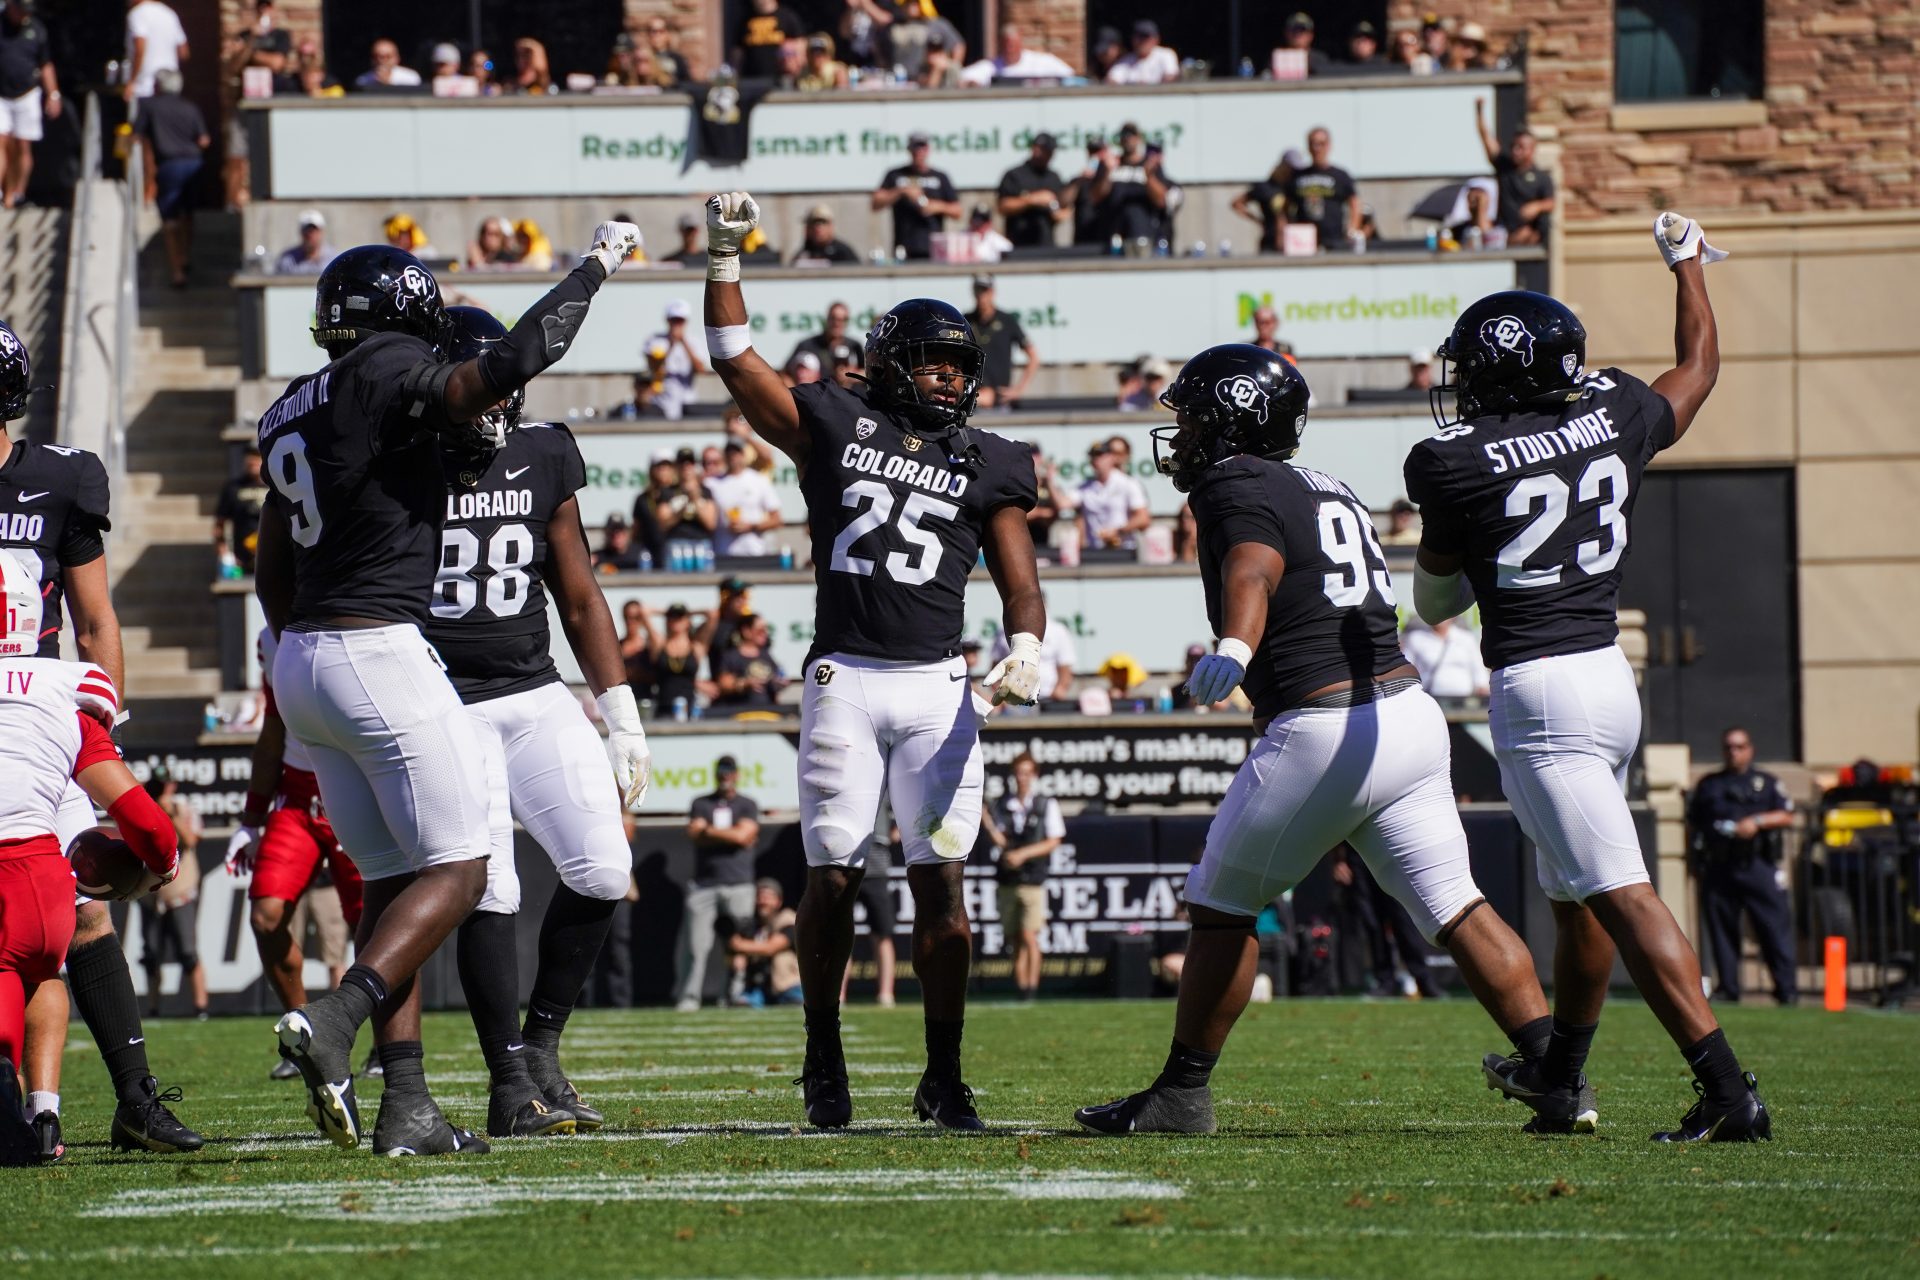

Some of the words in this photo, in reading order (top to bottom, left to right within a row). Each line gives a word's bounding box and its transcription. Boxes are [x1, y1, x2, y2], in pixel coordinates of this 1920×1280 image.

[756, 133, 847, 154] smart
[860, 126, 998, 154] finncial
[330, 304, 341, 323] 9
[1285, 293, 1458, 321] nerdwallet
[1494, 319, 1525, 350] CU
[1230, 378, 1260, 408] CU
[1484, 407, 1619, 474] STOUTMIRE
[841, 442, 968, 498] COLORADO
[267, 431, 323, 549] 9
[446, 489, 533, 521] LORADO
[829, 479, 960, 586] 25
[1496, 453, 1629, 588] 23
[429, 523, 534, 619] 88
[6, 671, 33, 695] IV
[814, 664, 835, 688] CU
[1029, 737, 1131, 763] team's
[1134, 732, 1248, 765] making
[1104, 772, 1176, 800] your
